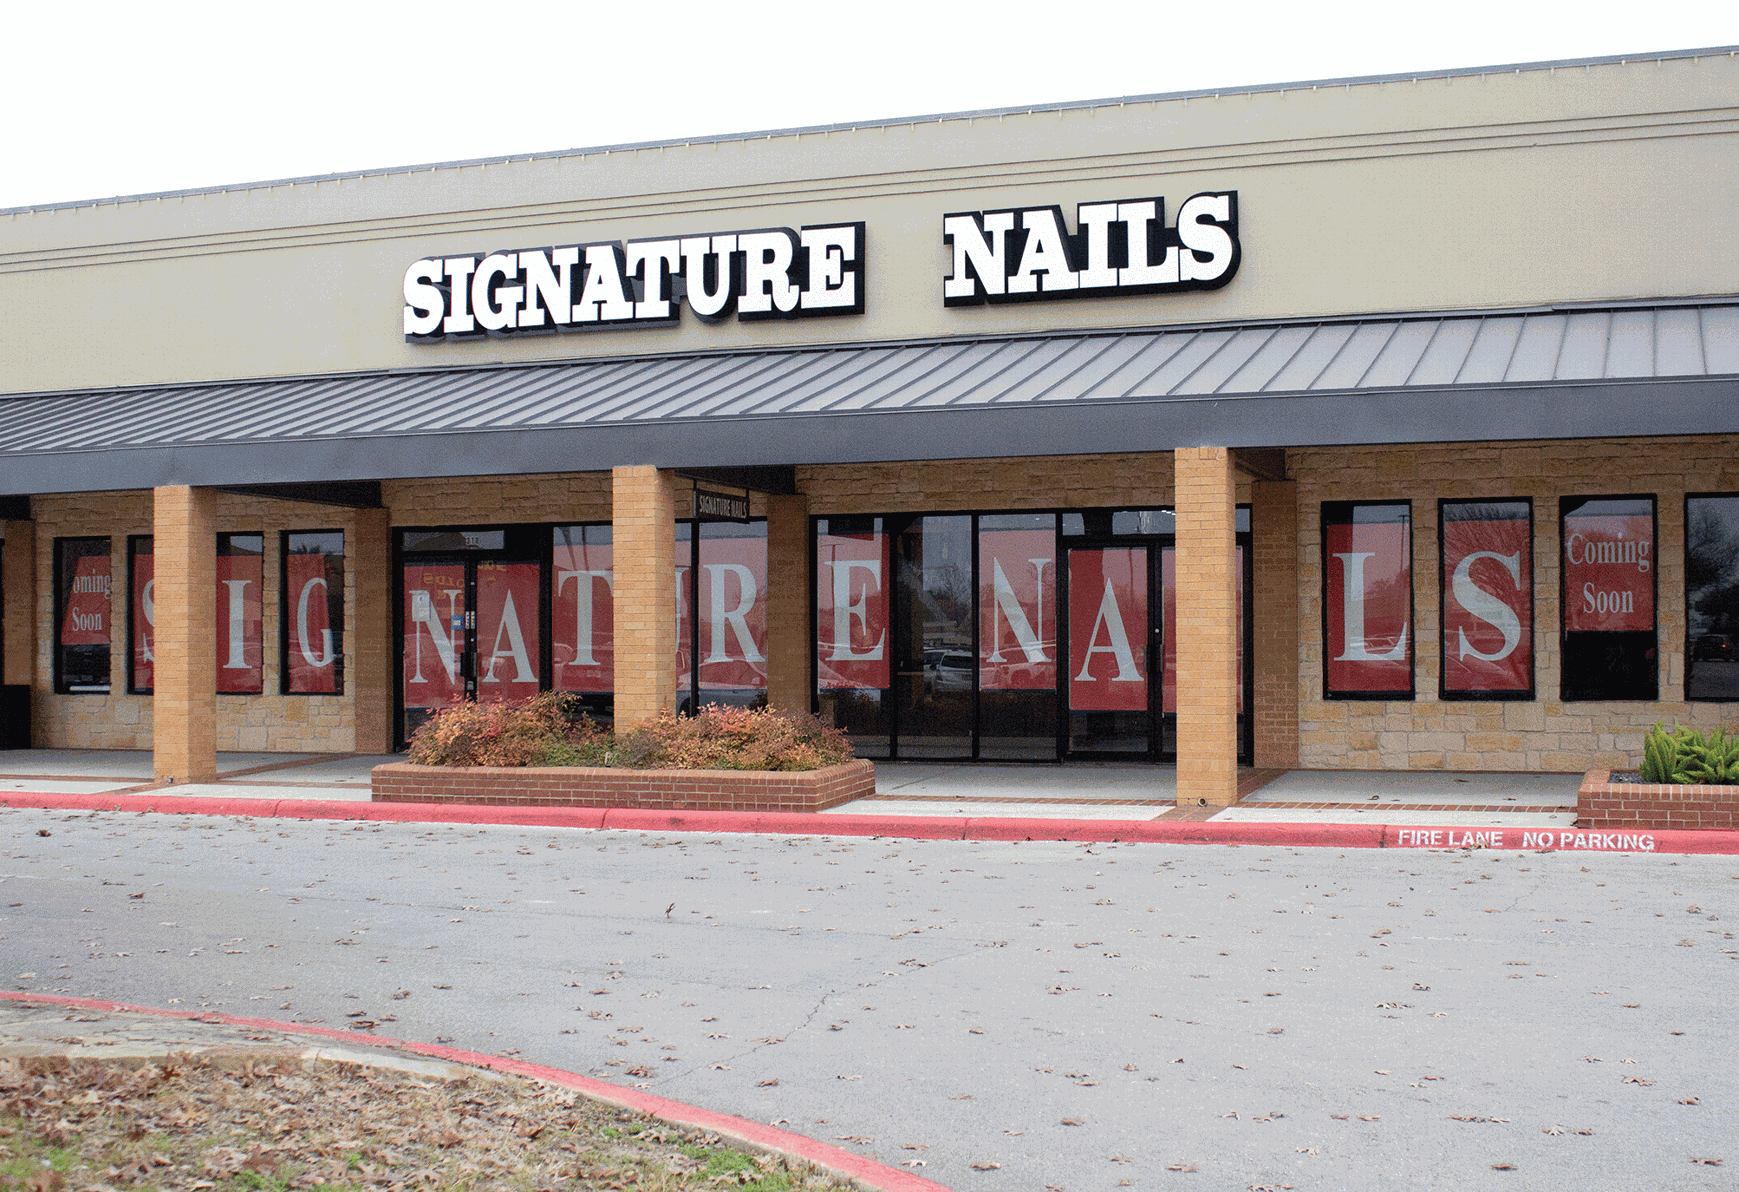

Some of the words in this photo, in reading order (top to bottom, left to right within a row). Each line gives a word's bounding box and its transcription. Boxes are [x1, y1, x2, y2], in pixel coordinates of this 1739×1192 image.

[403, 226, 856, 335] SIGNATURE
[944, 195, 1233, 297] NAILS
[699, 494, 730, 516] SIGNATURE
[1567, 532, 1650, 573] Coming
[73, 568, 112, 600] oming
[1583, 581, 1634, 614] Soon
[72, 606, 103, 631] Soon
[1398, 829, 1443, 846] FIRE
[1449, 831, 1503, 848] LANE
[1522, 832, 1554, 848] NO
[1560, 832, 1655, 851] PARKING
